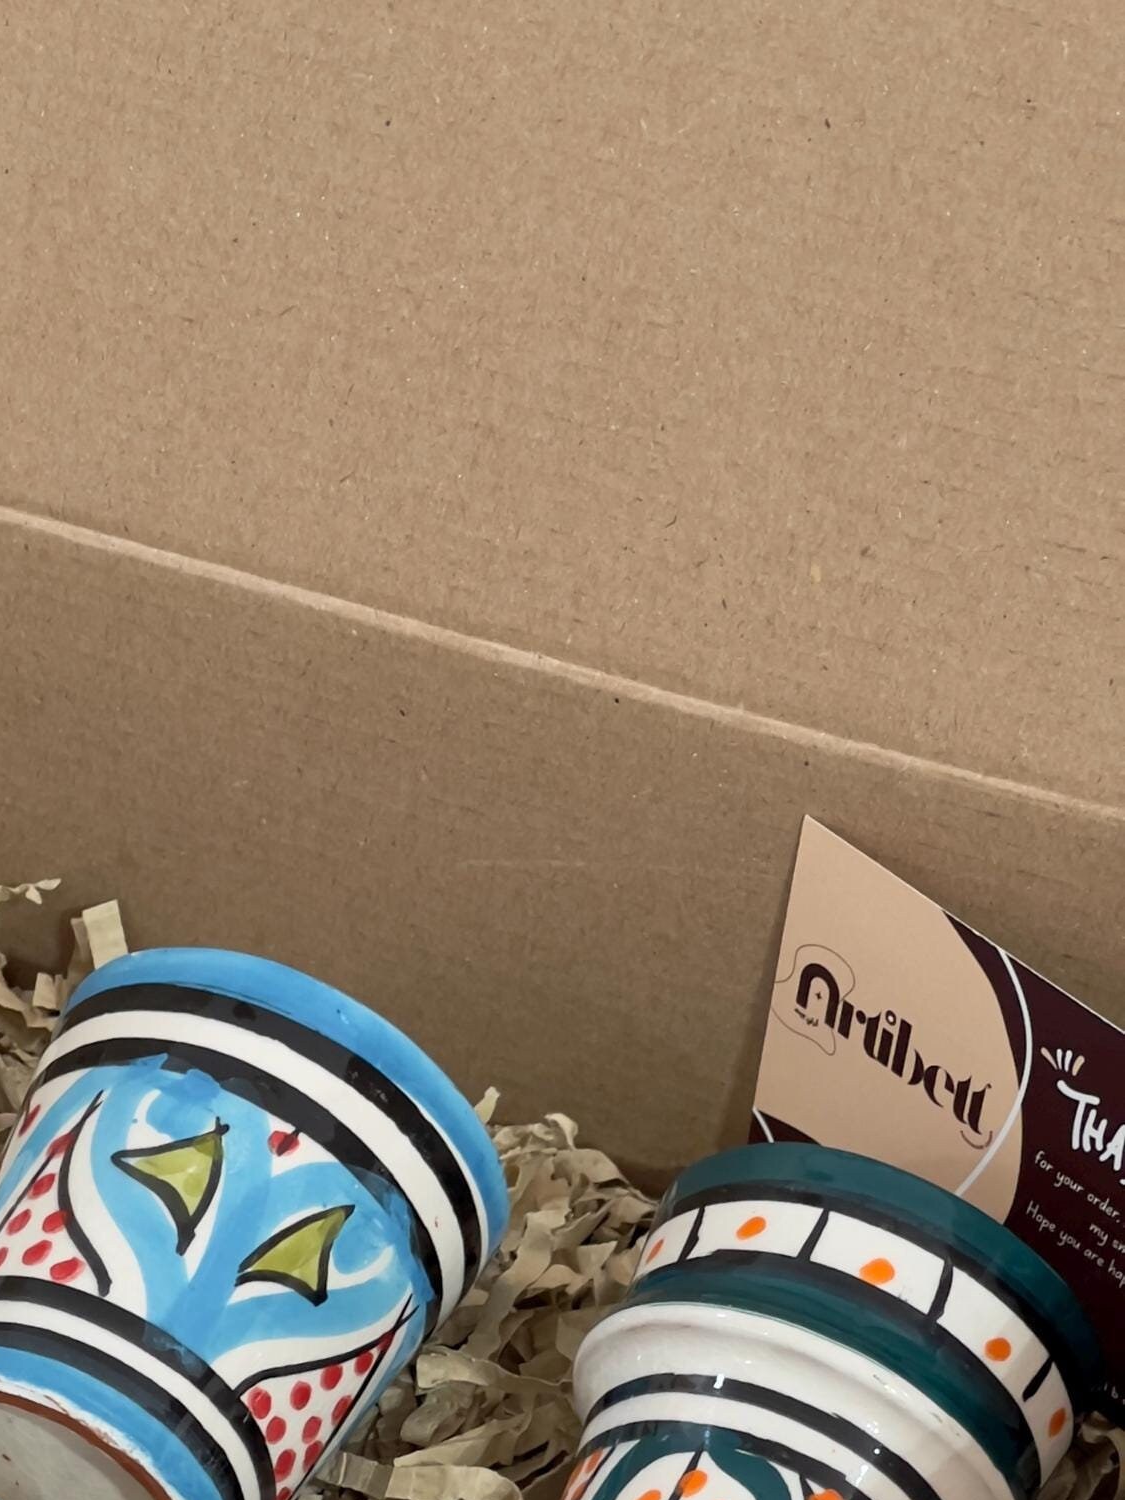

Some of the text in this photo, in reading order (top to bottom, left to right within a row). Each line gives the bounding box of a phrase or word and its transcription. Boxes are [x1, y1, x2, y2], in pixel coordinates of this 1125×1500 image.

[1034, 1150, 1121, 1223] for your order.
[1026, 1199, 1057, 1233] Hope
[1056, 1230, 1082, 1250] you
[1083, 1248, 1105, 1268] are
[1088, 1223, 1110, 1247] my
